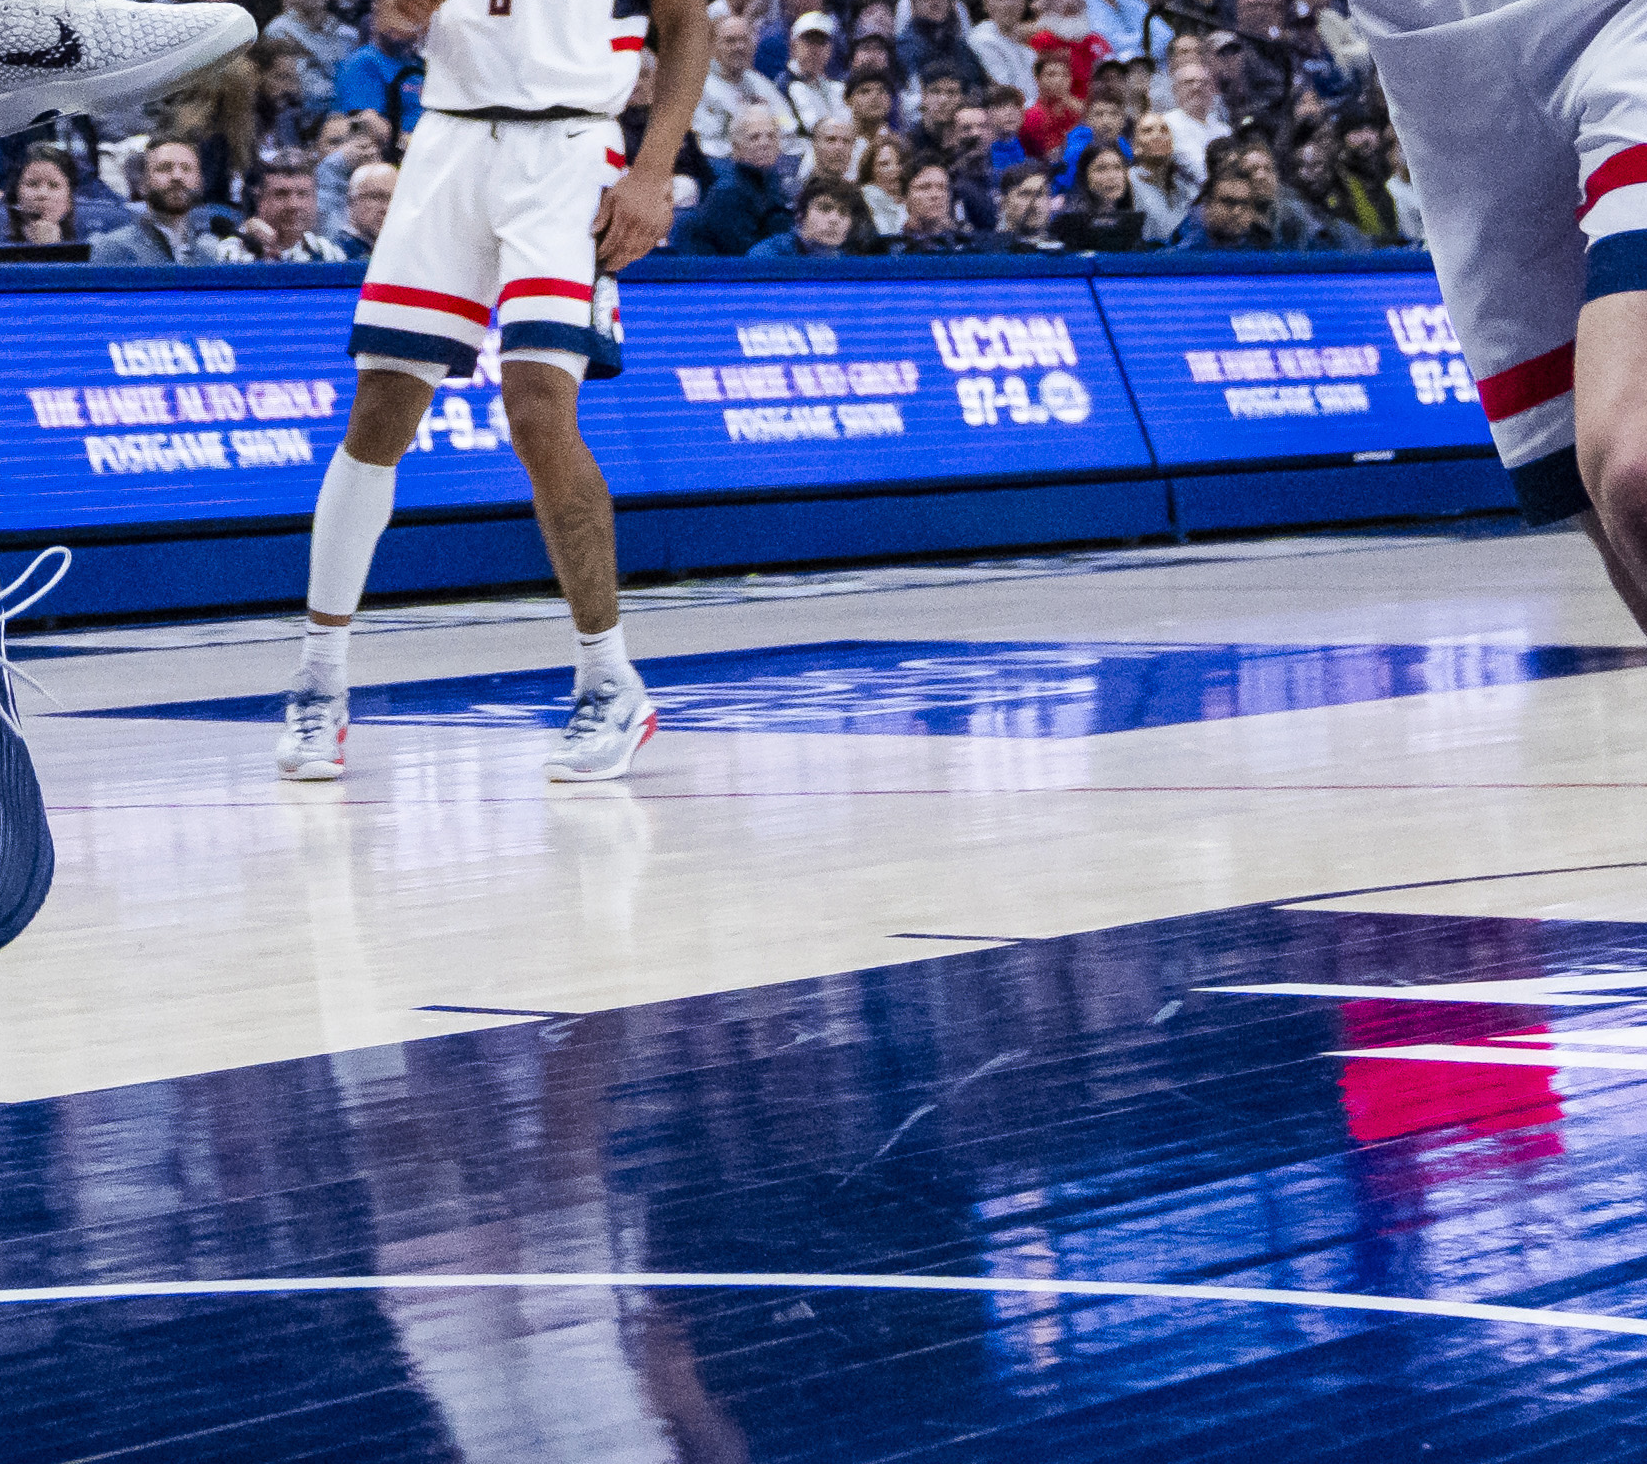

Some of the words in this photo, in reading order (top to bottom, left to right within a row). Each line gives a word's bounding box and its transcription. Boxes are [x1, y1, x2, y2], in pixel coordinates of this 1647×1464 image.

[109, 338, 198, 377] LISTEN
[197, 336, 238, 375] TO
[930, 313, 1079, 373] UCONN
[83, 431, 232, 475] POSTGAME
[229, 426, 315, 468] SHOW
